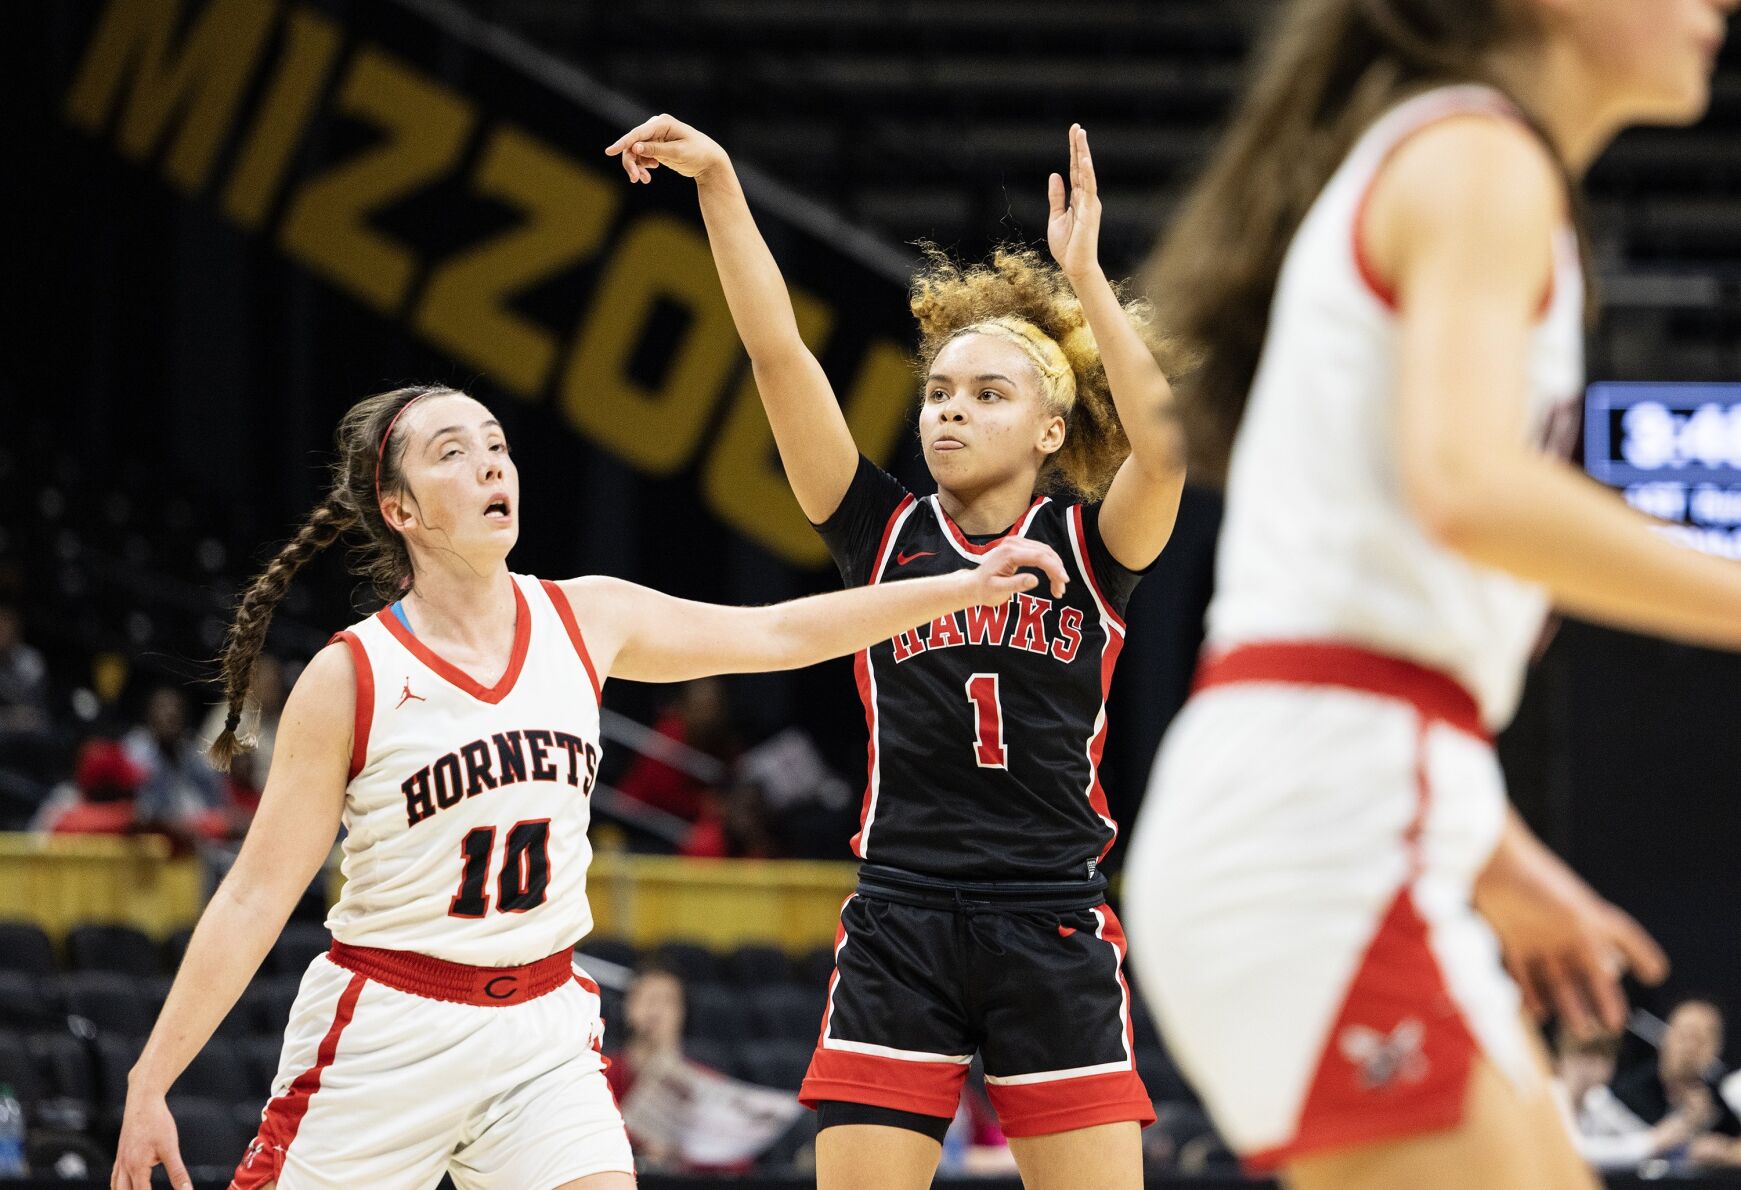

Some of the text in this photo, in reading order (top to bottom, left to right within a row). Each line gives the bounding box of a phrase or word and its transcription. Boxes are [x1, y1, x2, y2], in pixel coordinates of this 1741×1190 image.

[60, 0, 918, 570] MIZZOU
[965, 672, 1008, 771] 1
[401, 729, 598, 828] HORNETS
[448, 817, 552, 918] 10
[484, 975, 518, 999] C
